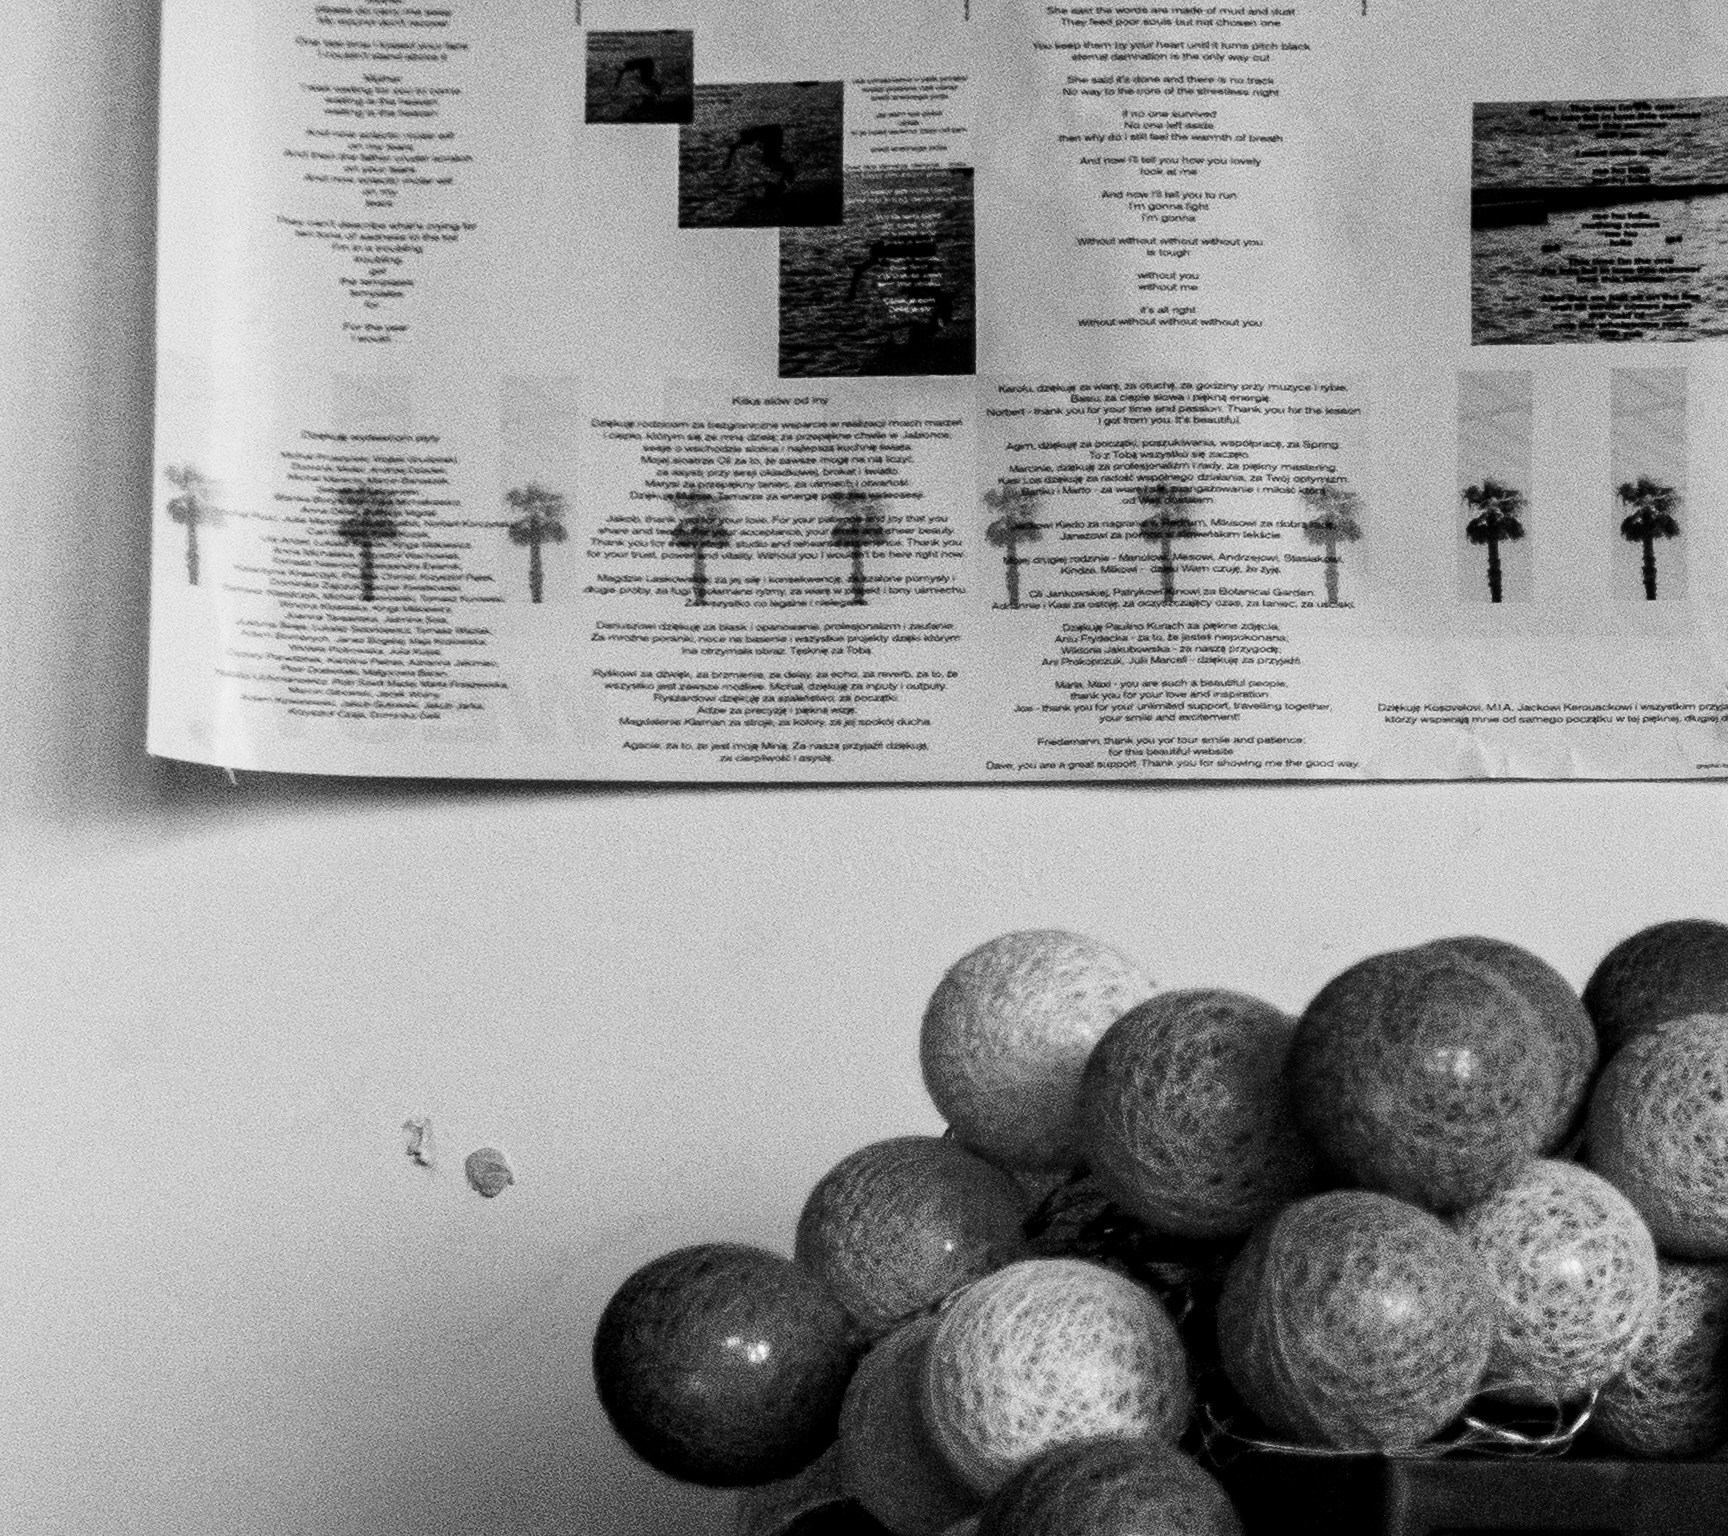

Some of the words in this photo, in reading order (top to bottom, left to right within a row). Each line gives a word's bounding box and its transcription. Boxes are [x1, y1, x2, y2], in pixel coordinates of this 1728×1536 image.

[1102, 191, 1123, 199] And
[1165, 191, 1179, 199] tell
[1148, 203, 1183, 212] gonna
[1161, 214, 1195, 222] gonna
[1118, 237, 1156, 245] without
[1201, 238, 1240, 246] without
[1243, 239, 1263, 247] you
[1159, 249, 1190, 258] tough
[1137, 272, 1176, 280] without
[1179, 272, 1199, 280] you
[1139, 283, 1176, 291] without
[1172, 306, 1195, 315] right
[1102, 692, 1120, 700] you
[1109, 748, 1122, 756] for
[1146, 747, 1190, 756] beautiful
